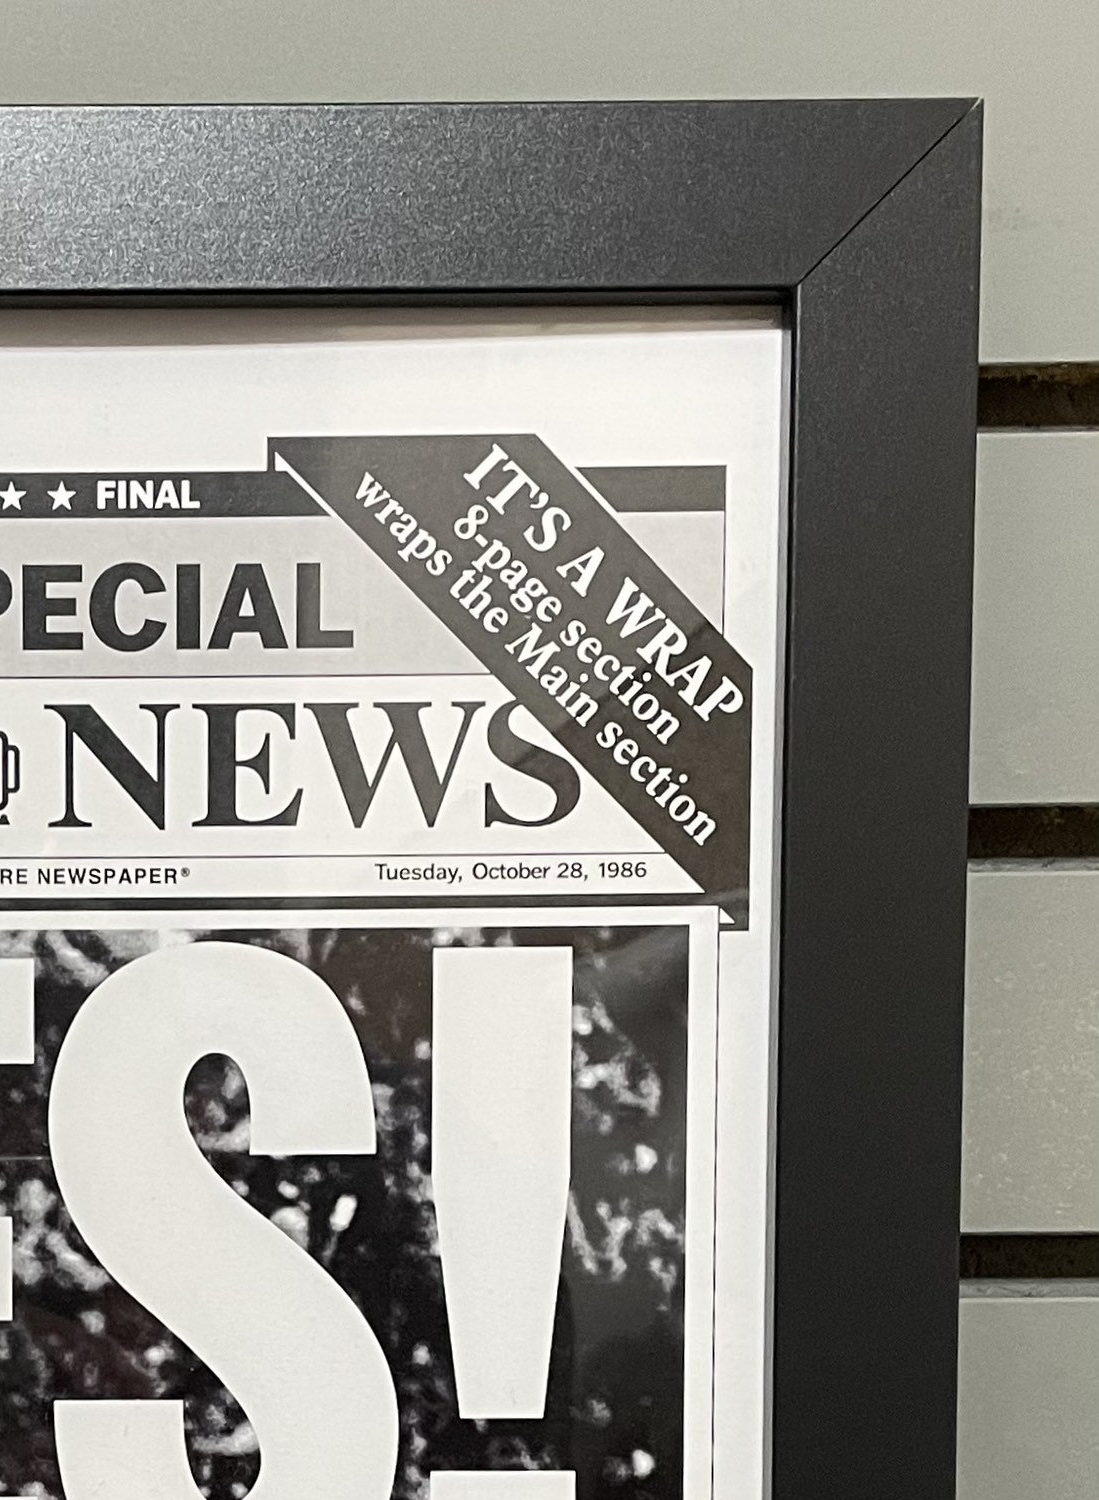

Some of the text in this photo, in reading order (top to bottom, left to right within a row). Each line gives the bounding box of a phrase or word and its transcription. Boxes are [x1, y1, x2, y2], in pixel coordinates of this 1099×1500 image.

[96, 479, 201, 510] FINAL
[463, 443, 744, 722] IT’S A WRAP
[355, 471, 716, 846] wraps the Main section
[454, 504, 680, 745] 8-page section
[43, 700, 582, 830] NEWS
[374, 861, 647, 884] Tuesday, October 28, 1986
